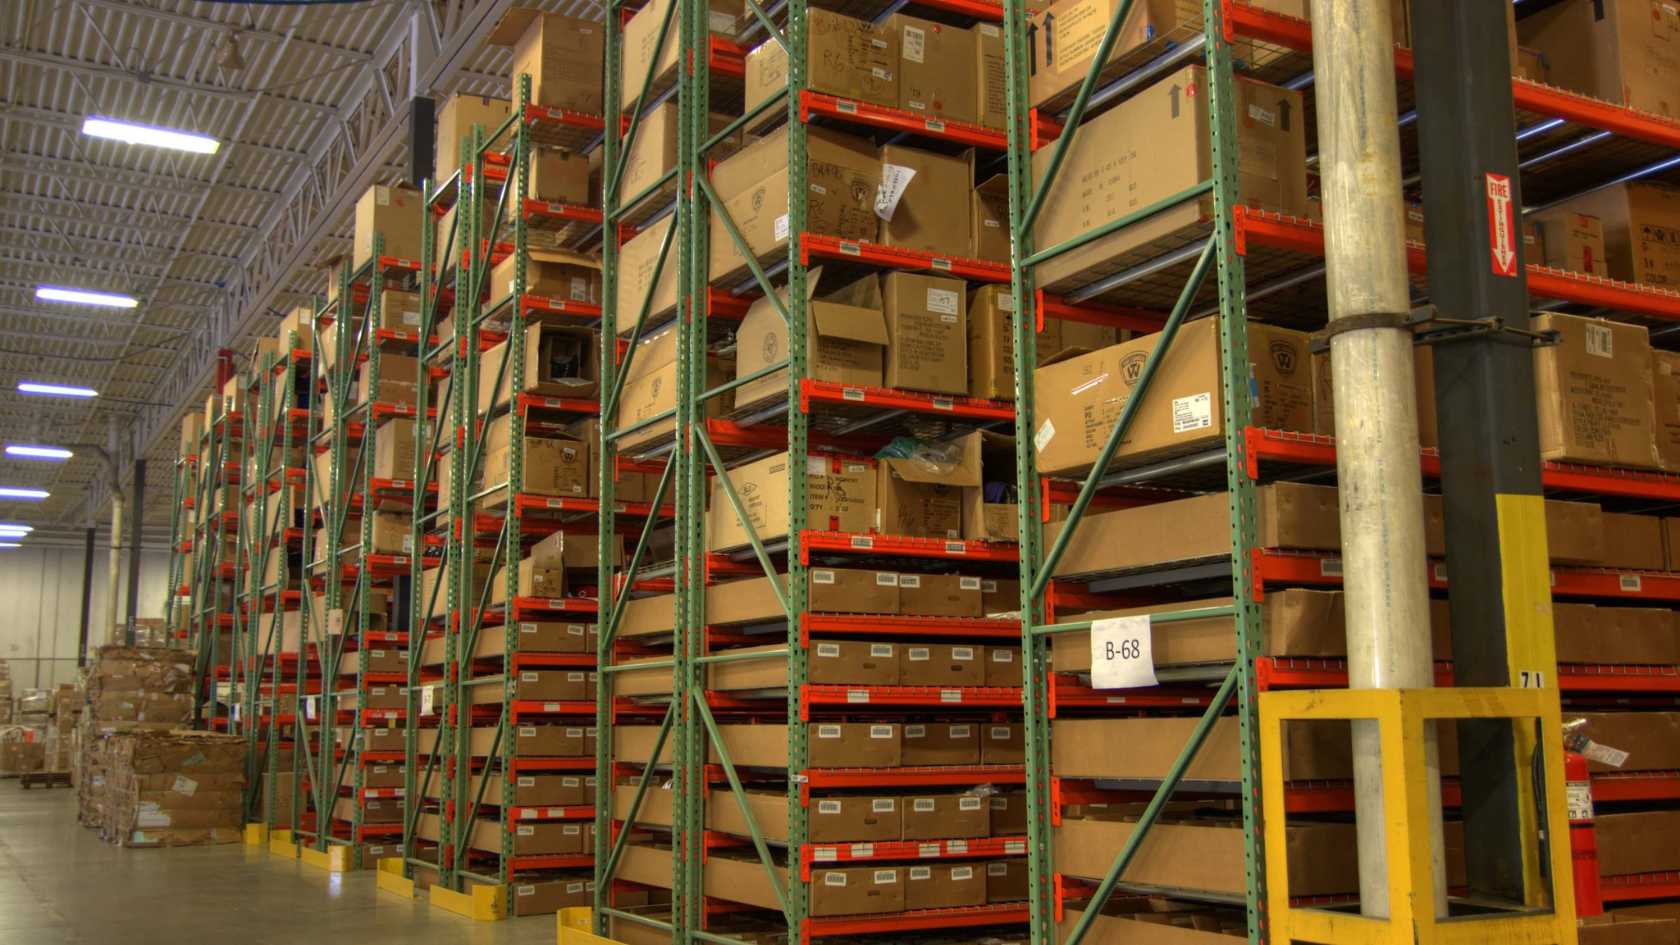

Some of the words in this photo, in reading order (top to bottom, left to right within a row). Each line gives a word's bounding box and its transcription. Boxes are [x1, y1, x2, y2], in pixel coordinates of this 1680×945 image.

[1490, 182, 1508, 198] FIRE
[1106, 639, 1140, 660] B-68
[1521, 671, 1541, 688] 71
